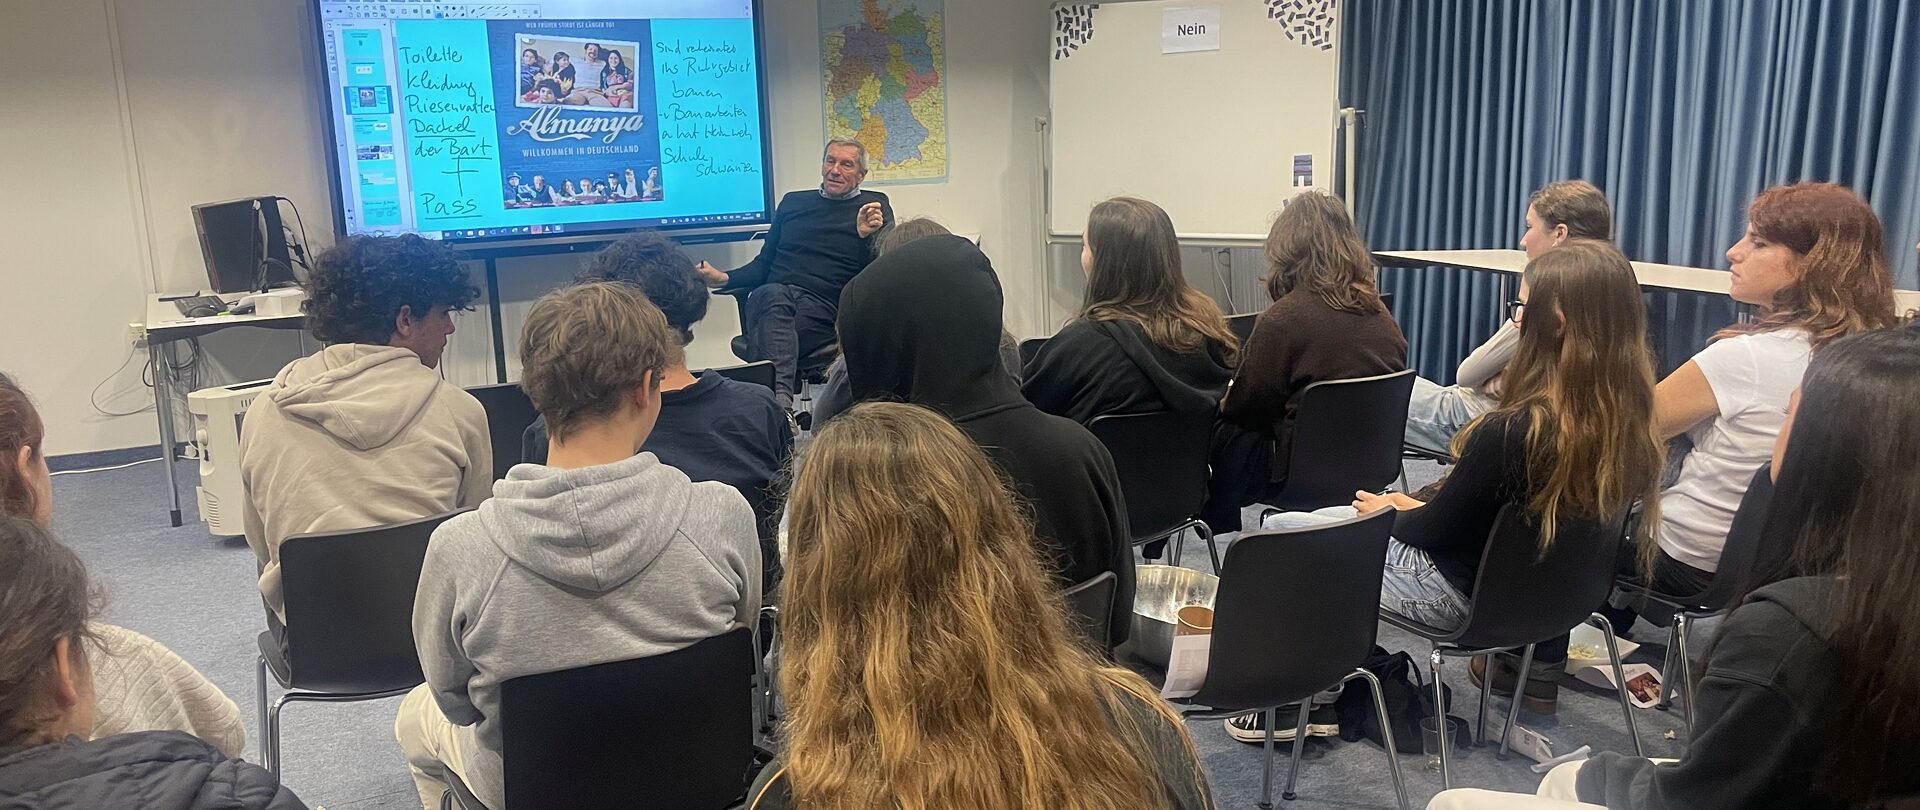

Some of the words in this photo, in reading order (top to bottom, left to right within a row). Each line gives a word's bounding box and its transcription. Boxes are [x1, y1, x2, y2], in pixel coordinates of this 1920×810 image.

[1178, 23, 1206, 36] Nein
[400, 45, 463, 64] Toilette
[506, 105, 644, 144] Almanya
[415, 140, 443, 157] der
[441, 137, 493, 156] Bart
[522, 148, 574, 158] WILLKOMMEN
[576, 147, 585, 155] IN
[587, 145, 639, 155] DEUTSCHLAND
[420, 193, 477, 215] Pass
